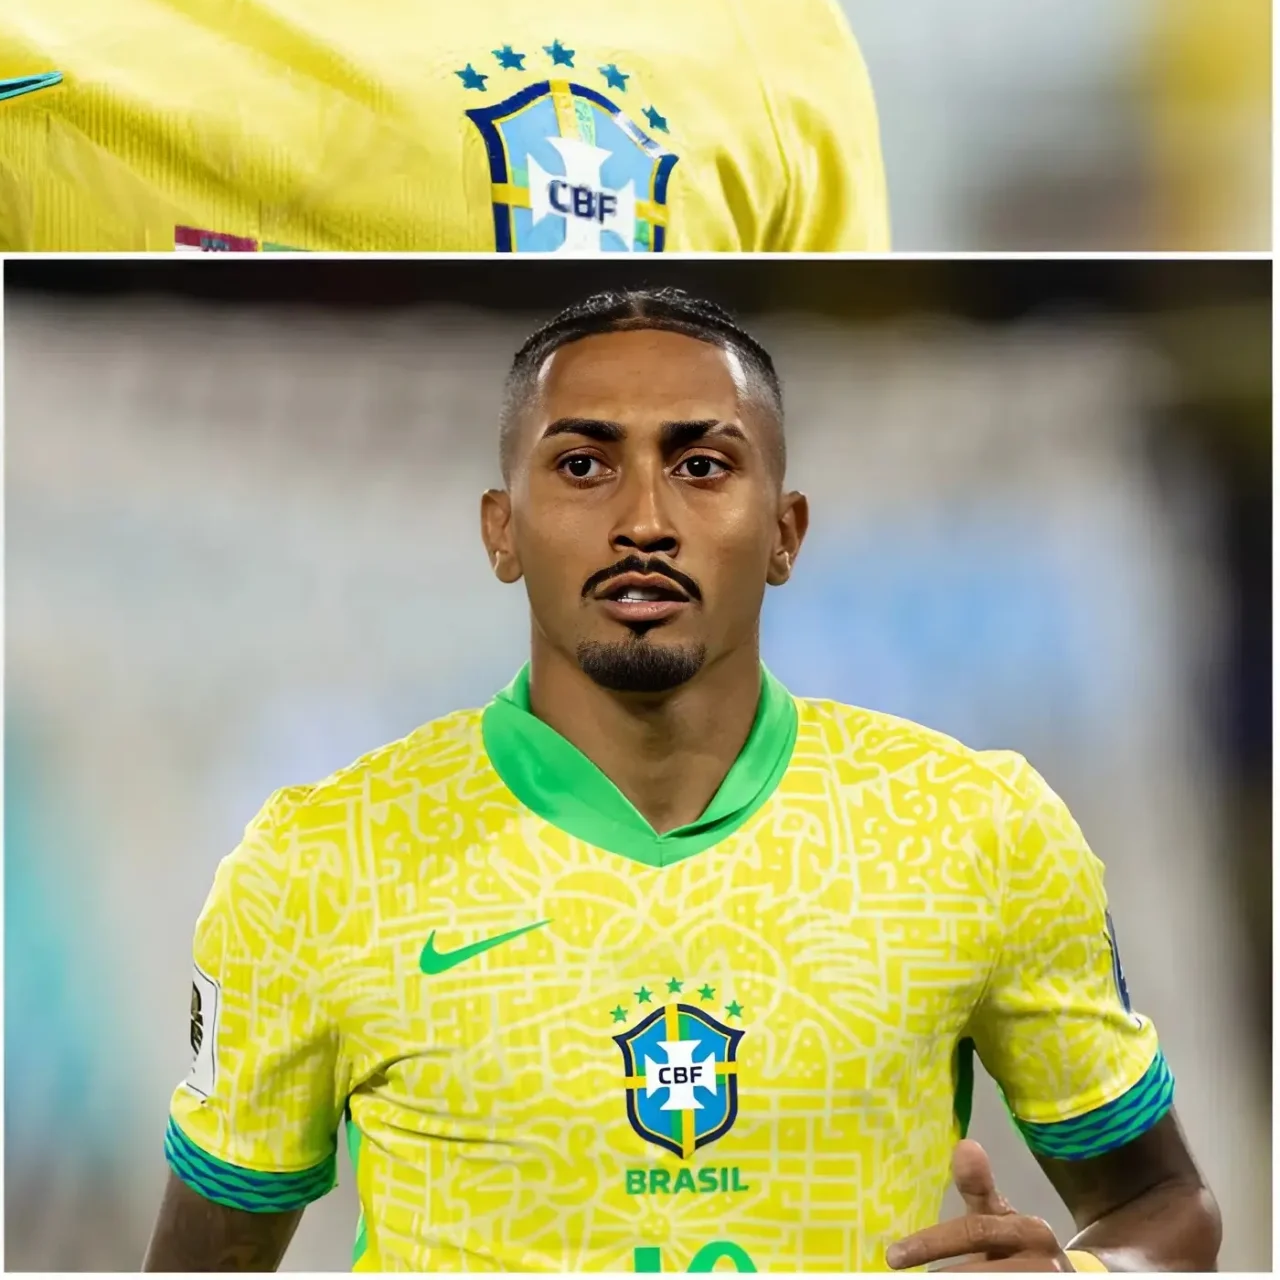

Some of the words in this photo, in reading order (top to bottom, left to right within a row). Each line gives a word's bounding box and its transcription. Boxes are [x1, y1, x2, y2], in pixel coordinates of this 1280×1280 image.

[548, 179, 618, 225] CBF
[658, 1065, 703, 1085] CBF
[625, 1166, 750, 1195] BRASIL
